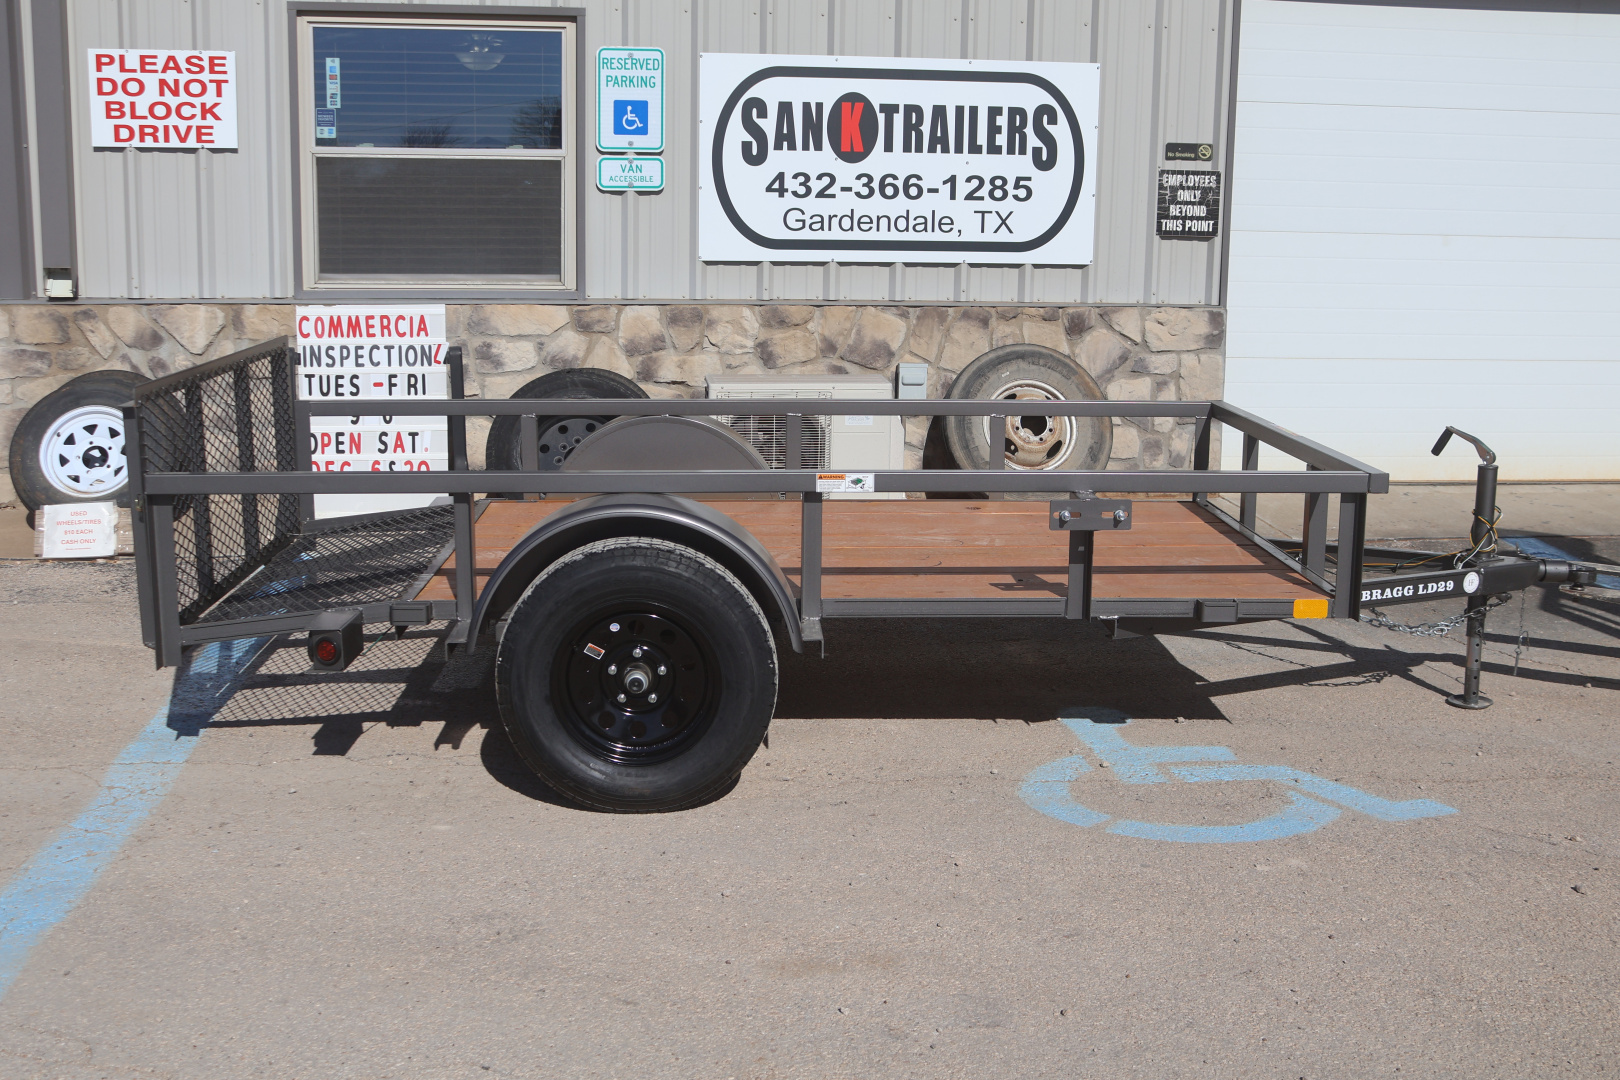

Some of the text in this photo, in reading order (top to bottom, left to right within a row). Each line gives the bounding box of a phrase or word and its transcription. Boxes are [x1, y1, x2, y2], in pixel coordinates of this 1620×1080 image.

[95, 53, 228, 75] PLEASE
[601, 57, 660, 71] RESERVED
[96, 77, 229, 98] DO NOT
[605, 74, 656, 88] PARKING
[105, 100, 223, 121] BLOCK
[113, 124, 215, 144] DRIVE
[620, 163, 643, 174] VAN
[608, 175, 654, 183] ACCESSIBLE
[765, 171, 1033, 202] 432-366-1285
[1162, 174, 1217, 187] EMPLOYEES
[1177, 189, 1201, 202] ONLY
[1169, 205, 1207, 217] BEYOND
[782, 207, 1014, 238] Gardendale, TX
[1161, 219, 1215, 232] THIS POINT
[298, 314, 429, 339] COMMERCIA
[304, 373, 360, 397] TUES
[1361, 580, 1454, 601] BRAGG LD29
